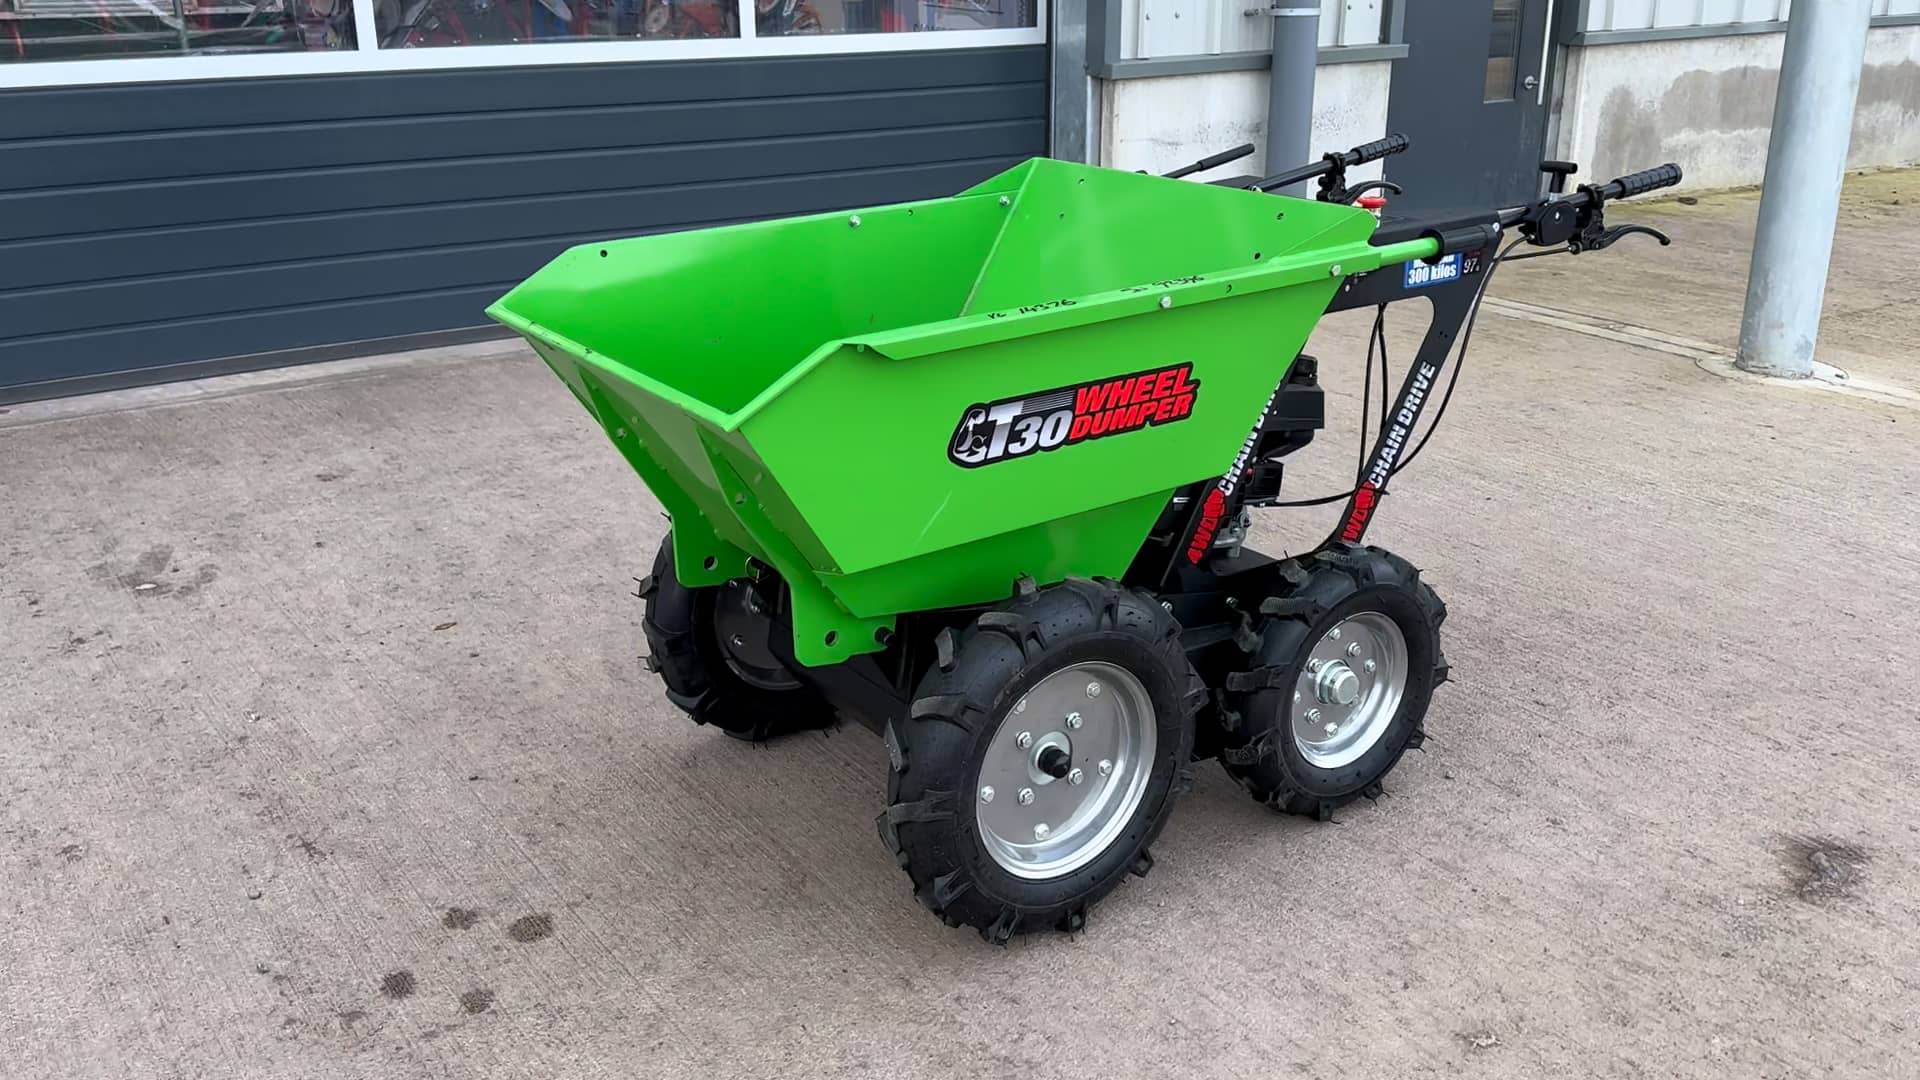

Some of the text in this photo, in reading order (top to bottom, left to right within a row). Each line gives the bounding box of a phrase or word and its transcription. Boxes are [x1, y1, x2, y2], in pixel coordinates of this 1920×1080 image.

[1408, 263, 1457, 285] 300 kilos
[1074, 367, 1197, 416] WHEEL
[1068, 393, 1194, 440] DUMPER
[1341, 360, 1436, 544] WD CHAIN DRIVE
[1187, 517, 1218, 564] 4WD
